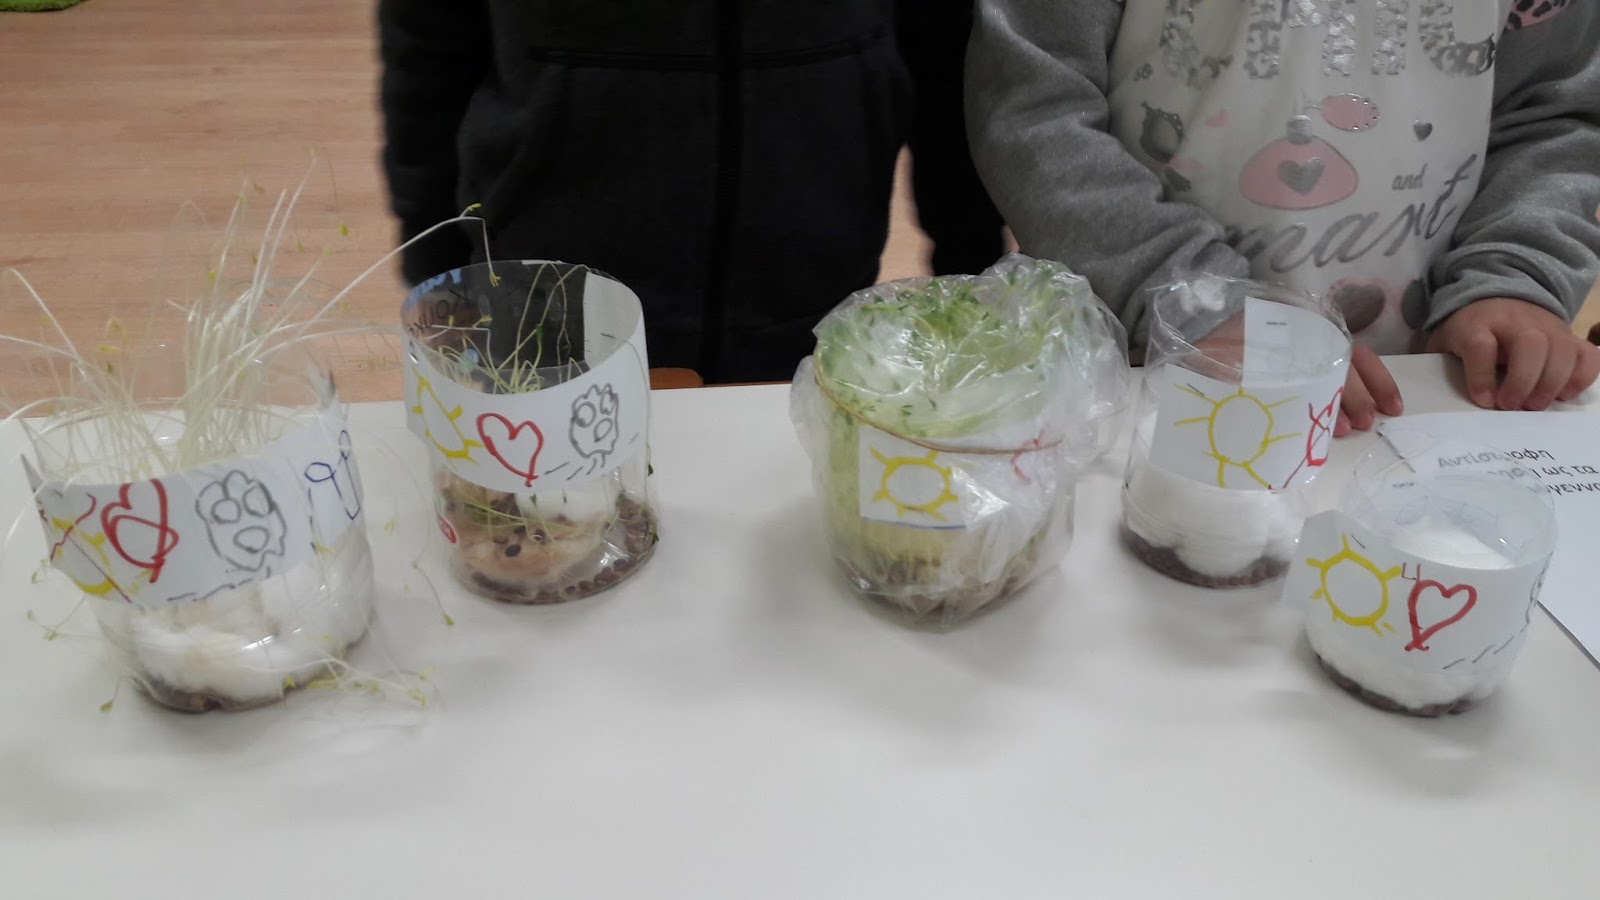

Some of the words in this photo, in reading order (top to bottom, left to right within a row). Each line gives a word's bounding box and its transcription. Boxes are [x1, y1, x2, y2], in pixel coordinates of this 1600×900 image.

[1391, 162, 1428, 190] and
[1222, 153, 1479, 273] mart
[1542, 466, 1573, 477] ως
[1571, 465, 1599, 474] τα
